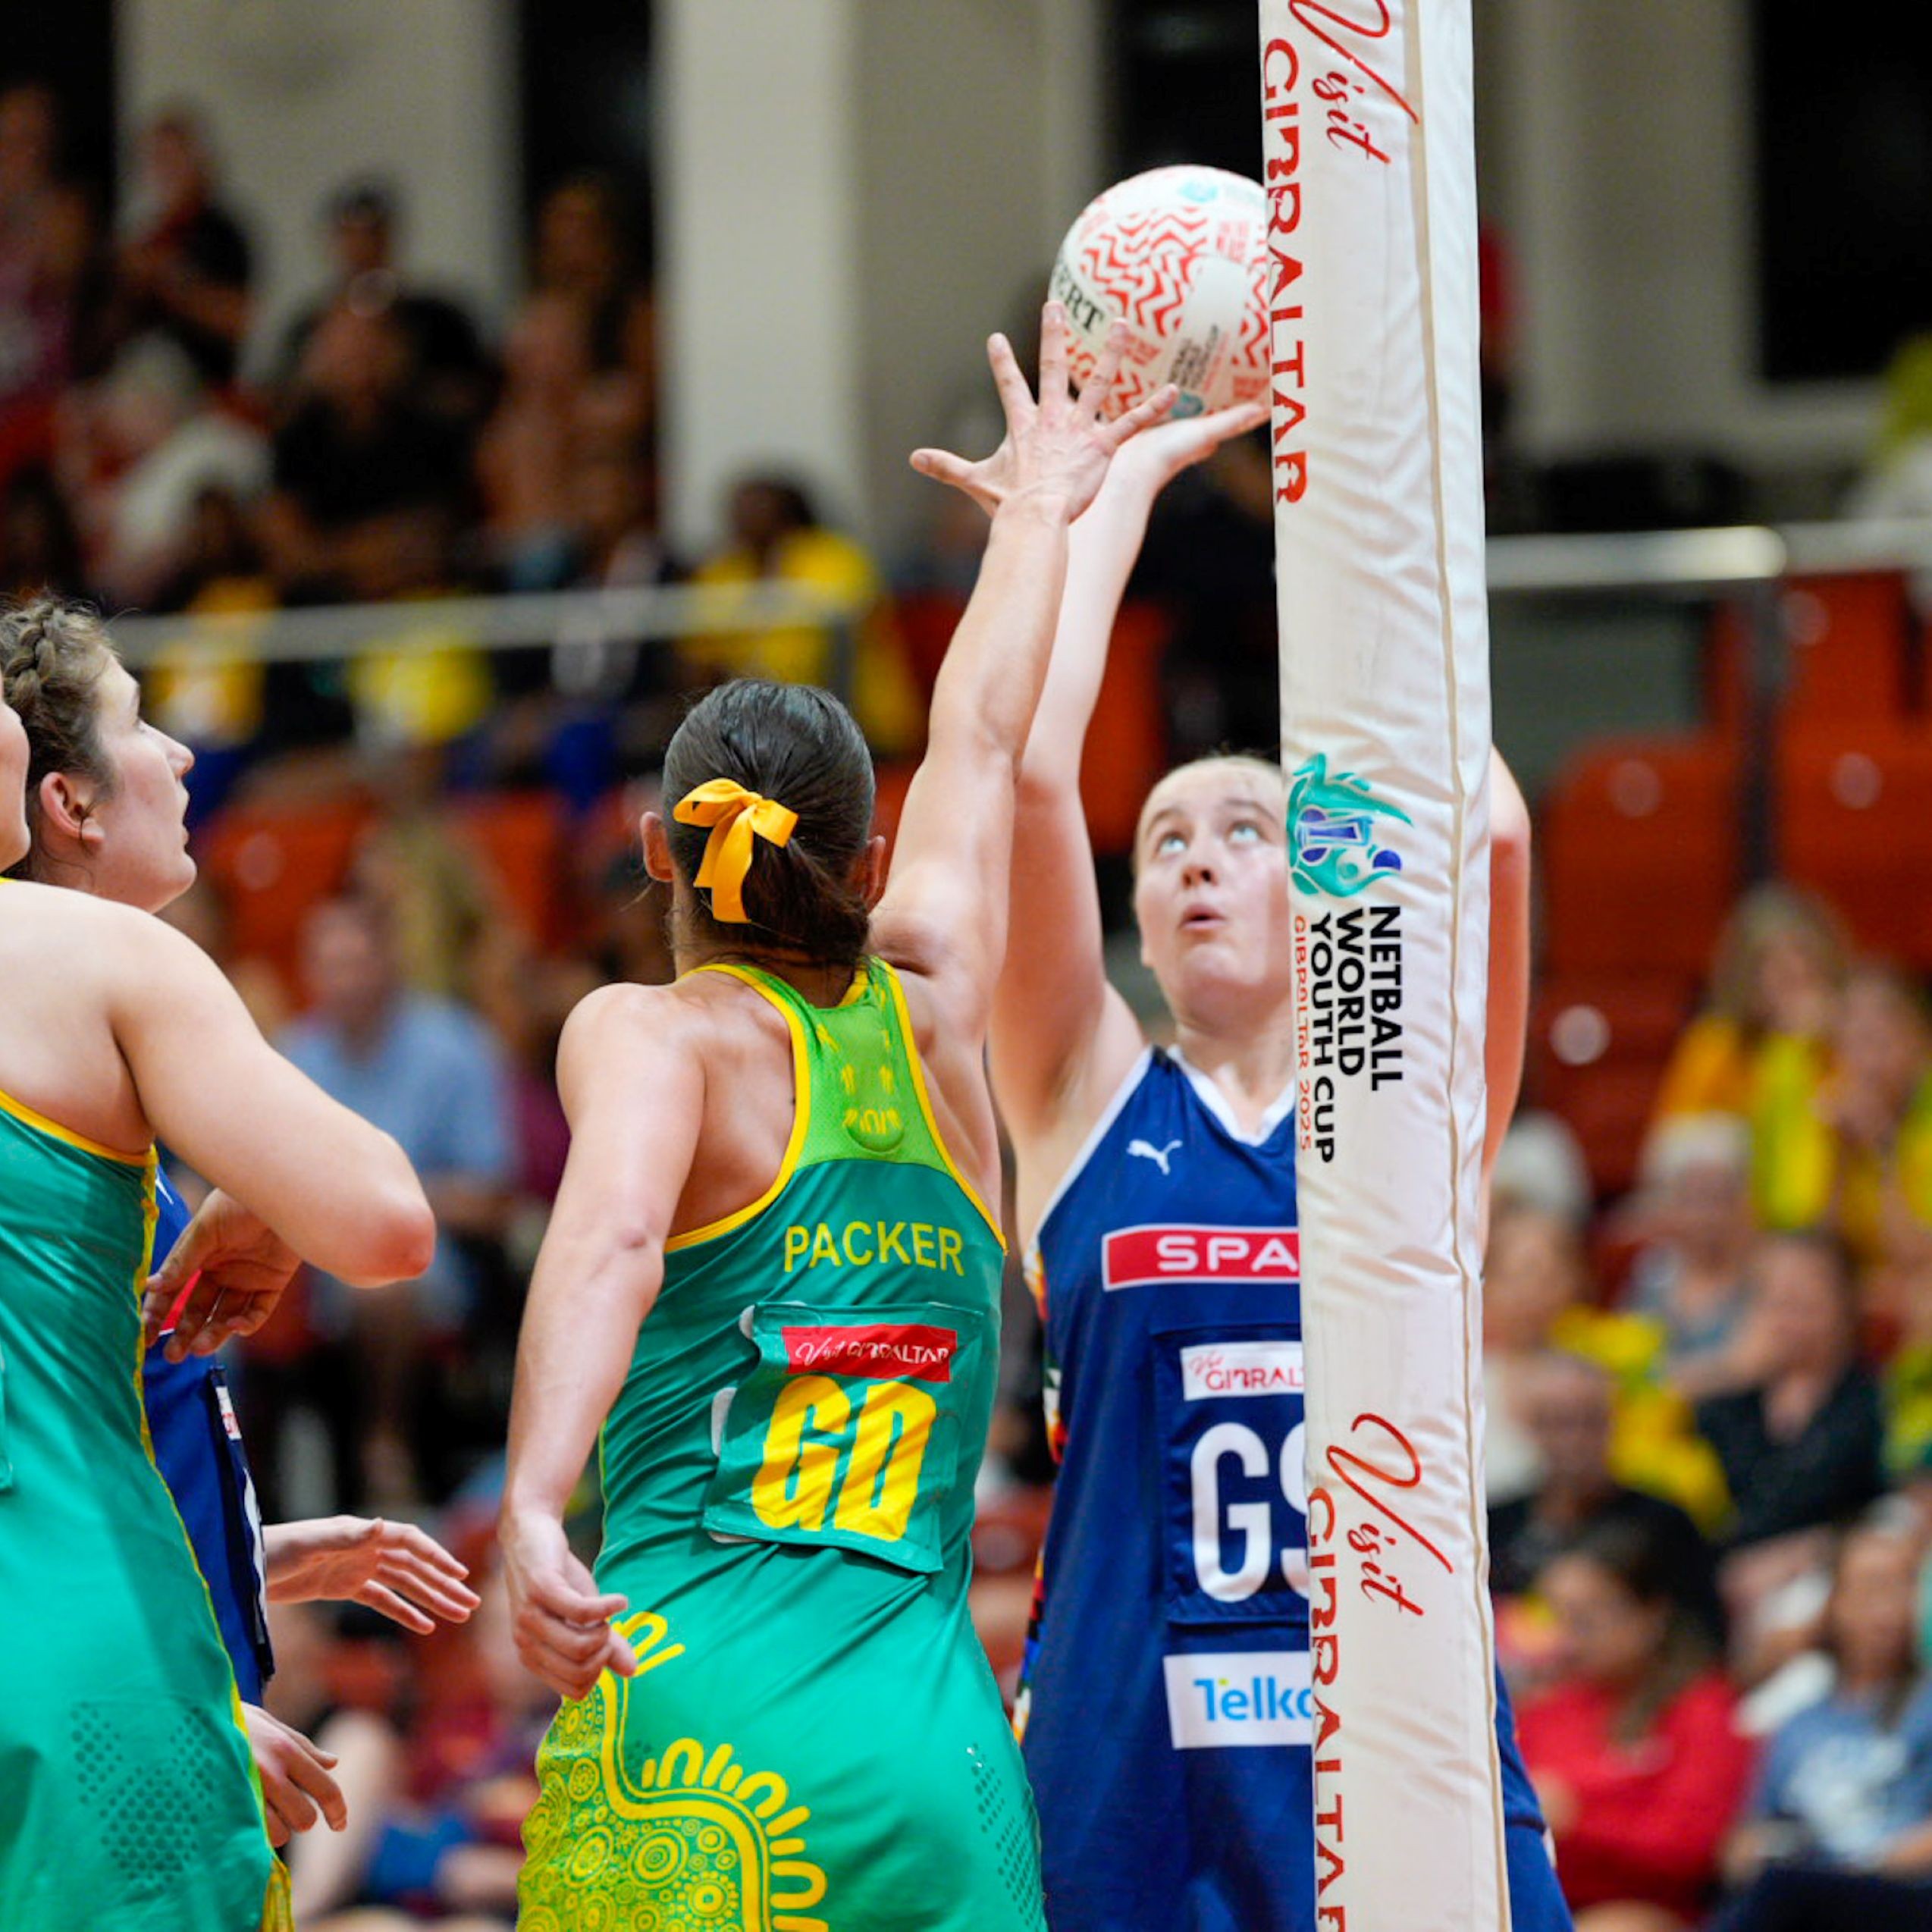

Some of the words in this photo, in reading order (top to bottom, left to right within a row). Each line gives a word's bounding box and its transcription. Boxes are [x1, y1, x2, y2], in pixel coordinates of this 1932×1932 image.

[1310, 912, 1333, 1066] YOUTH
[1336, 908, 1365, 1076] WORLD
[1369, 906, 1403, 1091] NETBALL
[1299, 1079, 1311, 1150] 2025
[1314, 1076, 1335, 1163] CUP
[784, 1221, 964, 1276] PACKER
[1156, 1235, 1299, 1272] SPA
[751, 1375, 937, 1542] GD
[1326, 1413, 1454, 1615] Visit
